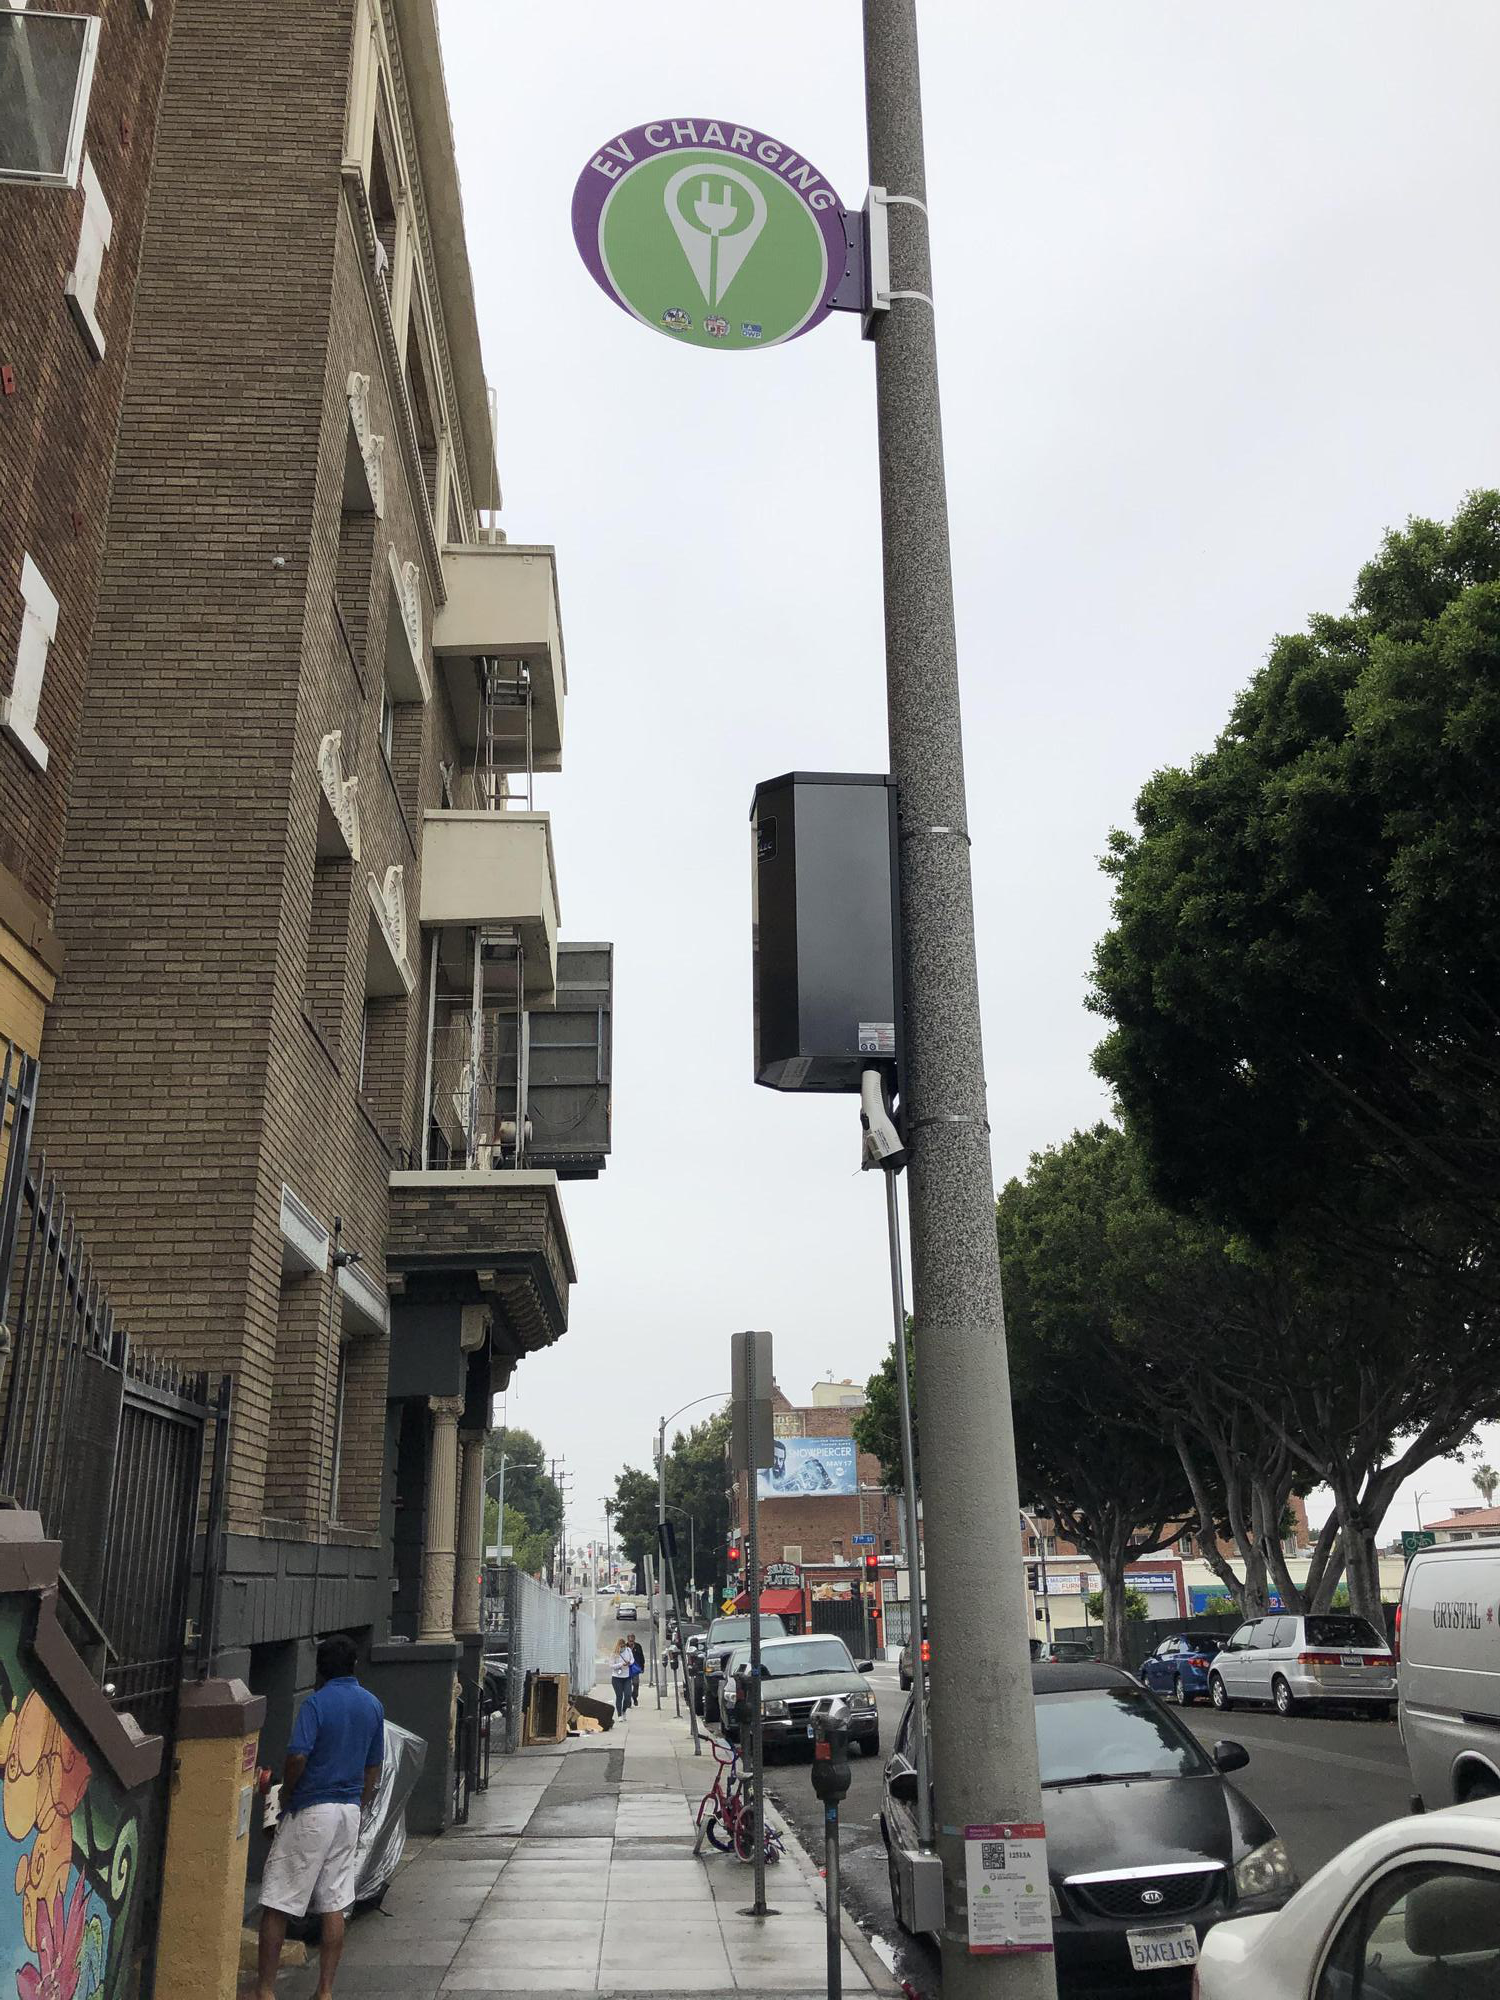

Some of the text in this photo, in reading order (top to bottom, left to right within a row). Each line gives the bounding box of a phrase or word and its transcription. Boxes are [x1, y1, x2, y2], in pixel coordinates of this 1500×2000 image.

[591, 121, 836, 212] EV CHARGING
[766, 1563, 797, 1575] SILVER
[763, 1575, 800, 1586] PLATTER
[1433, 1601, 1481, 1630] CRYSTAL
[1144, 1893, 1160, 1901] KIA
[1134, 1940, 1195, 1965] 5XXE115
